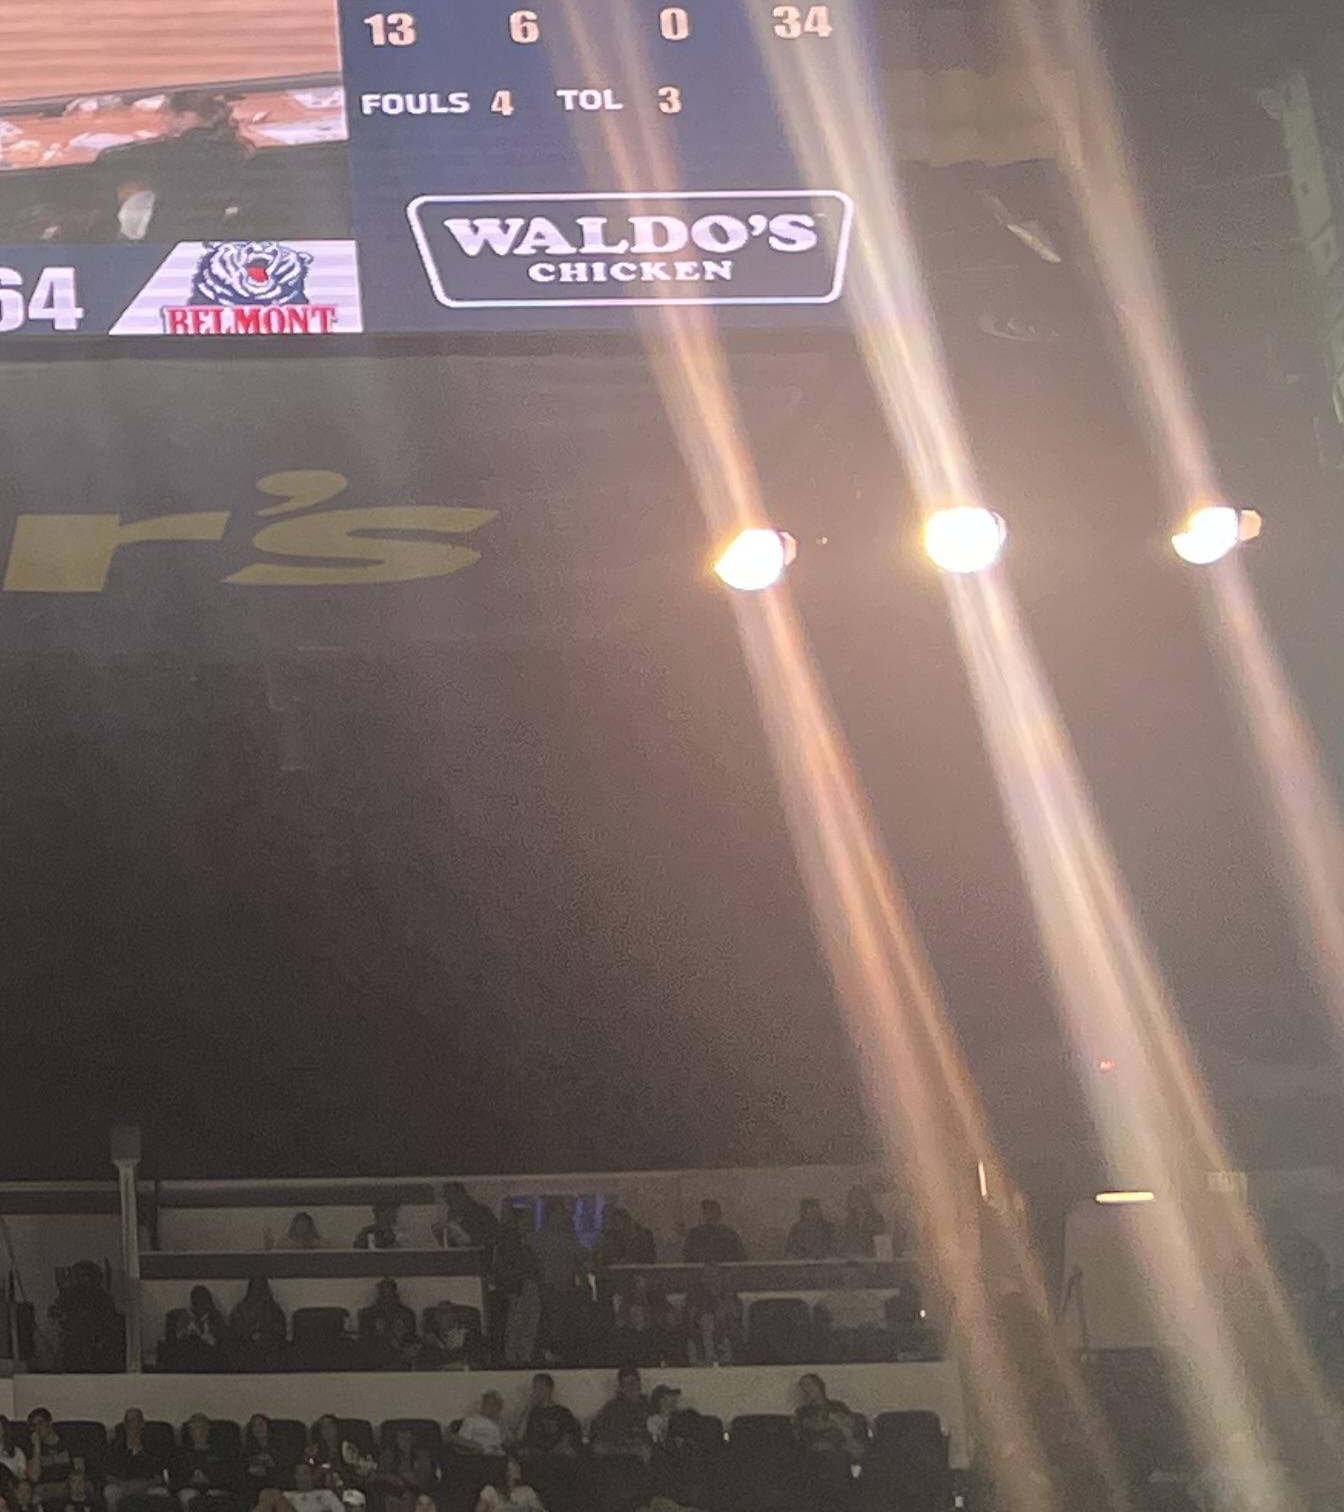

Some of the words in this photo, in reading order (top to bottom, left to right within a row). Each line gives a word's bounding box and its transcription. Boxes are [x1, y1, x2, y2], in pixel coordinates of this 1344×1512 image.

[364, 13, 416, 47] 13
[510, 10, 539, 44] 6
[660, 8, 689, 41] 0
[771, 5, 832, 39] 34
[361, 92, 470, 115] FOULS
[491, 90, 513, 116] 4
[557, 89, 623, 111] TOL
[658, 86, 683, 114] 3
[443, 213, 817, 257] WALDO'S
[527, 260, 733, 283] CHICKEN
